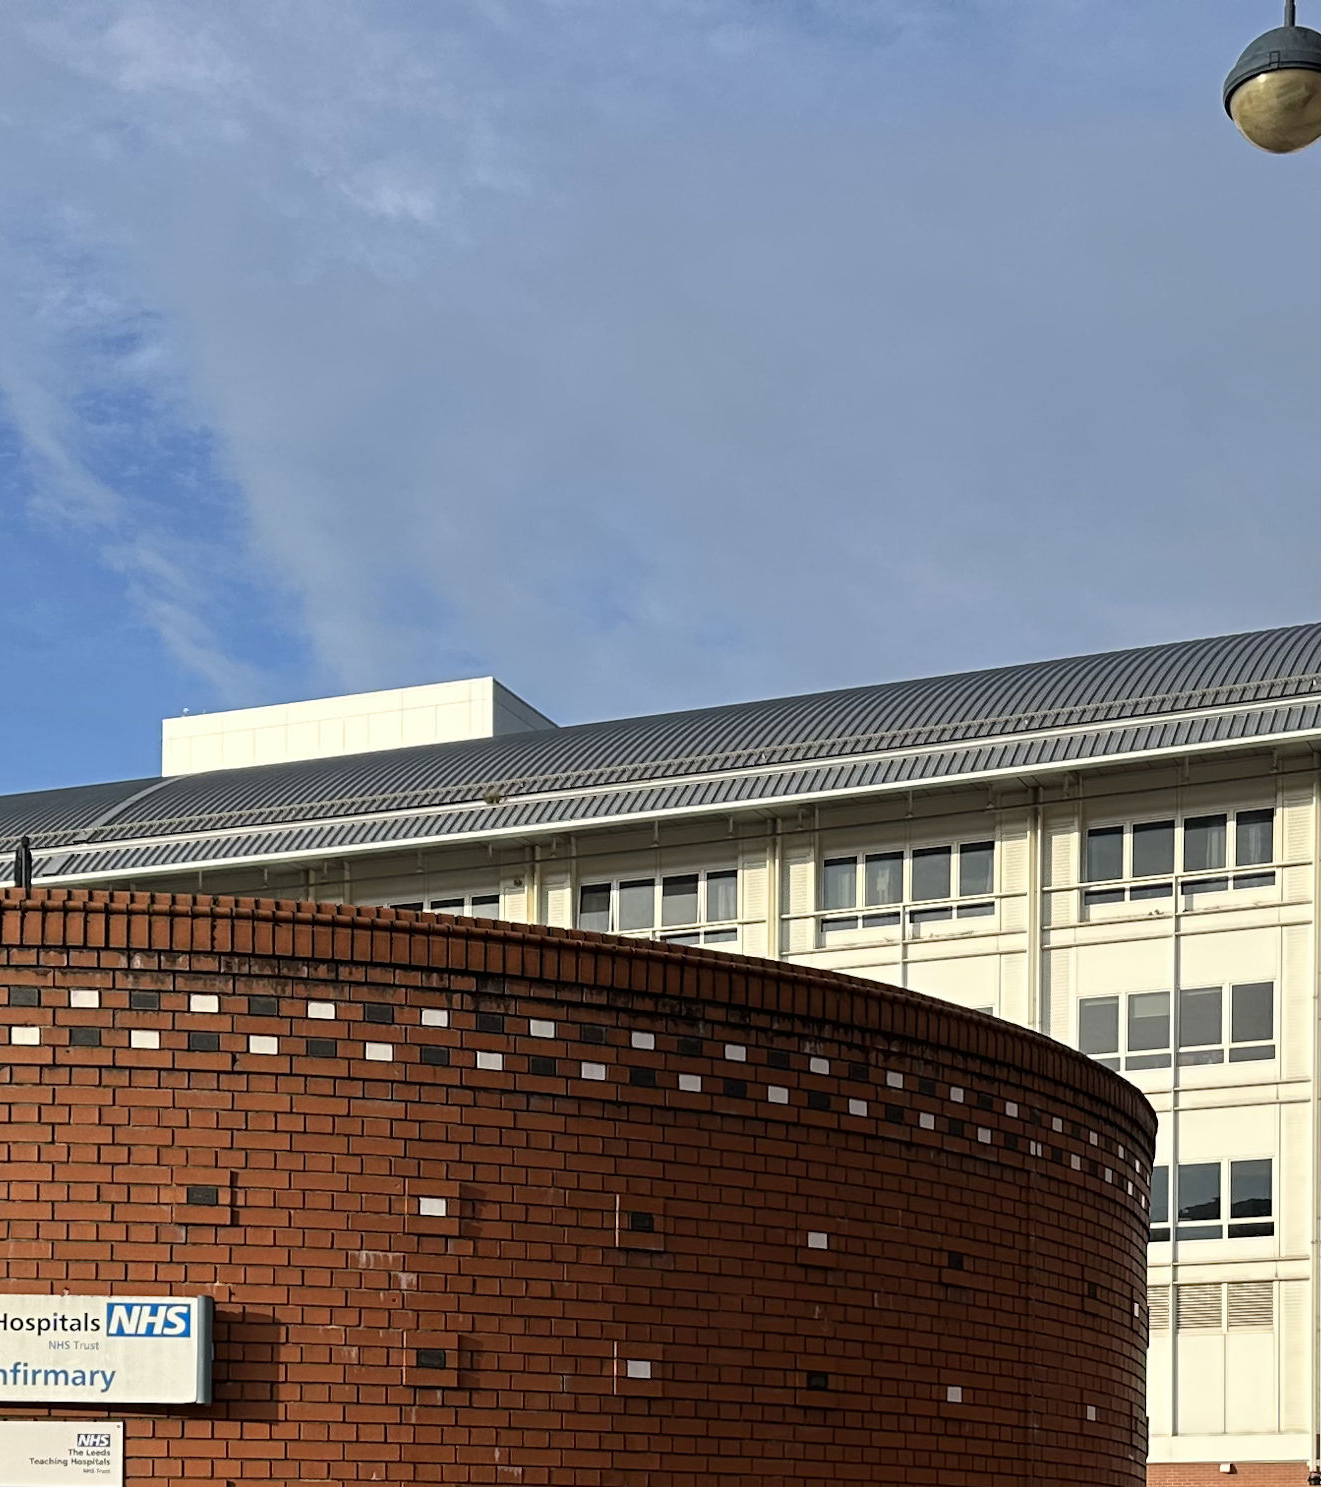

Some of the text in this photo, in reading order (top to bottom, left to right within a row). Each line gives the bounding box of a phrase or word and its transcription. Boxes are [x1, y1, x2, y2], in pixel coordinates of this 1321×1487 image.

[108, 1304, 190, 1335] NHS
[48, 1340, 100, 1350] NHS Trust
[78, 1434, 110, 1447] NHS
[68, 1448, 110, 1457] The Leeds
[29, 1457, 110, 1467] Teaching Hospitals
